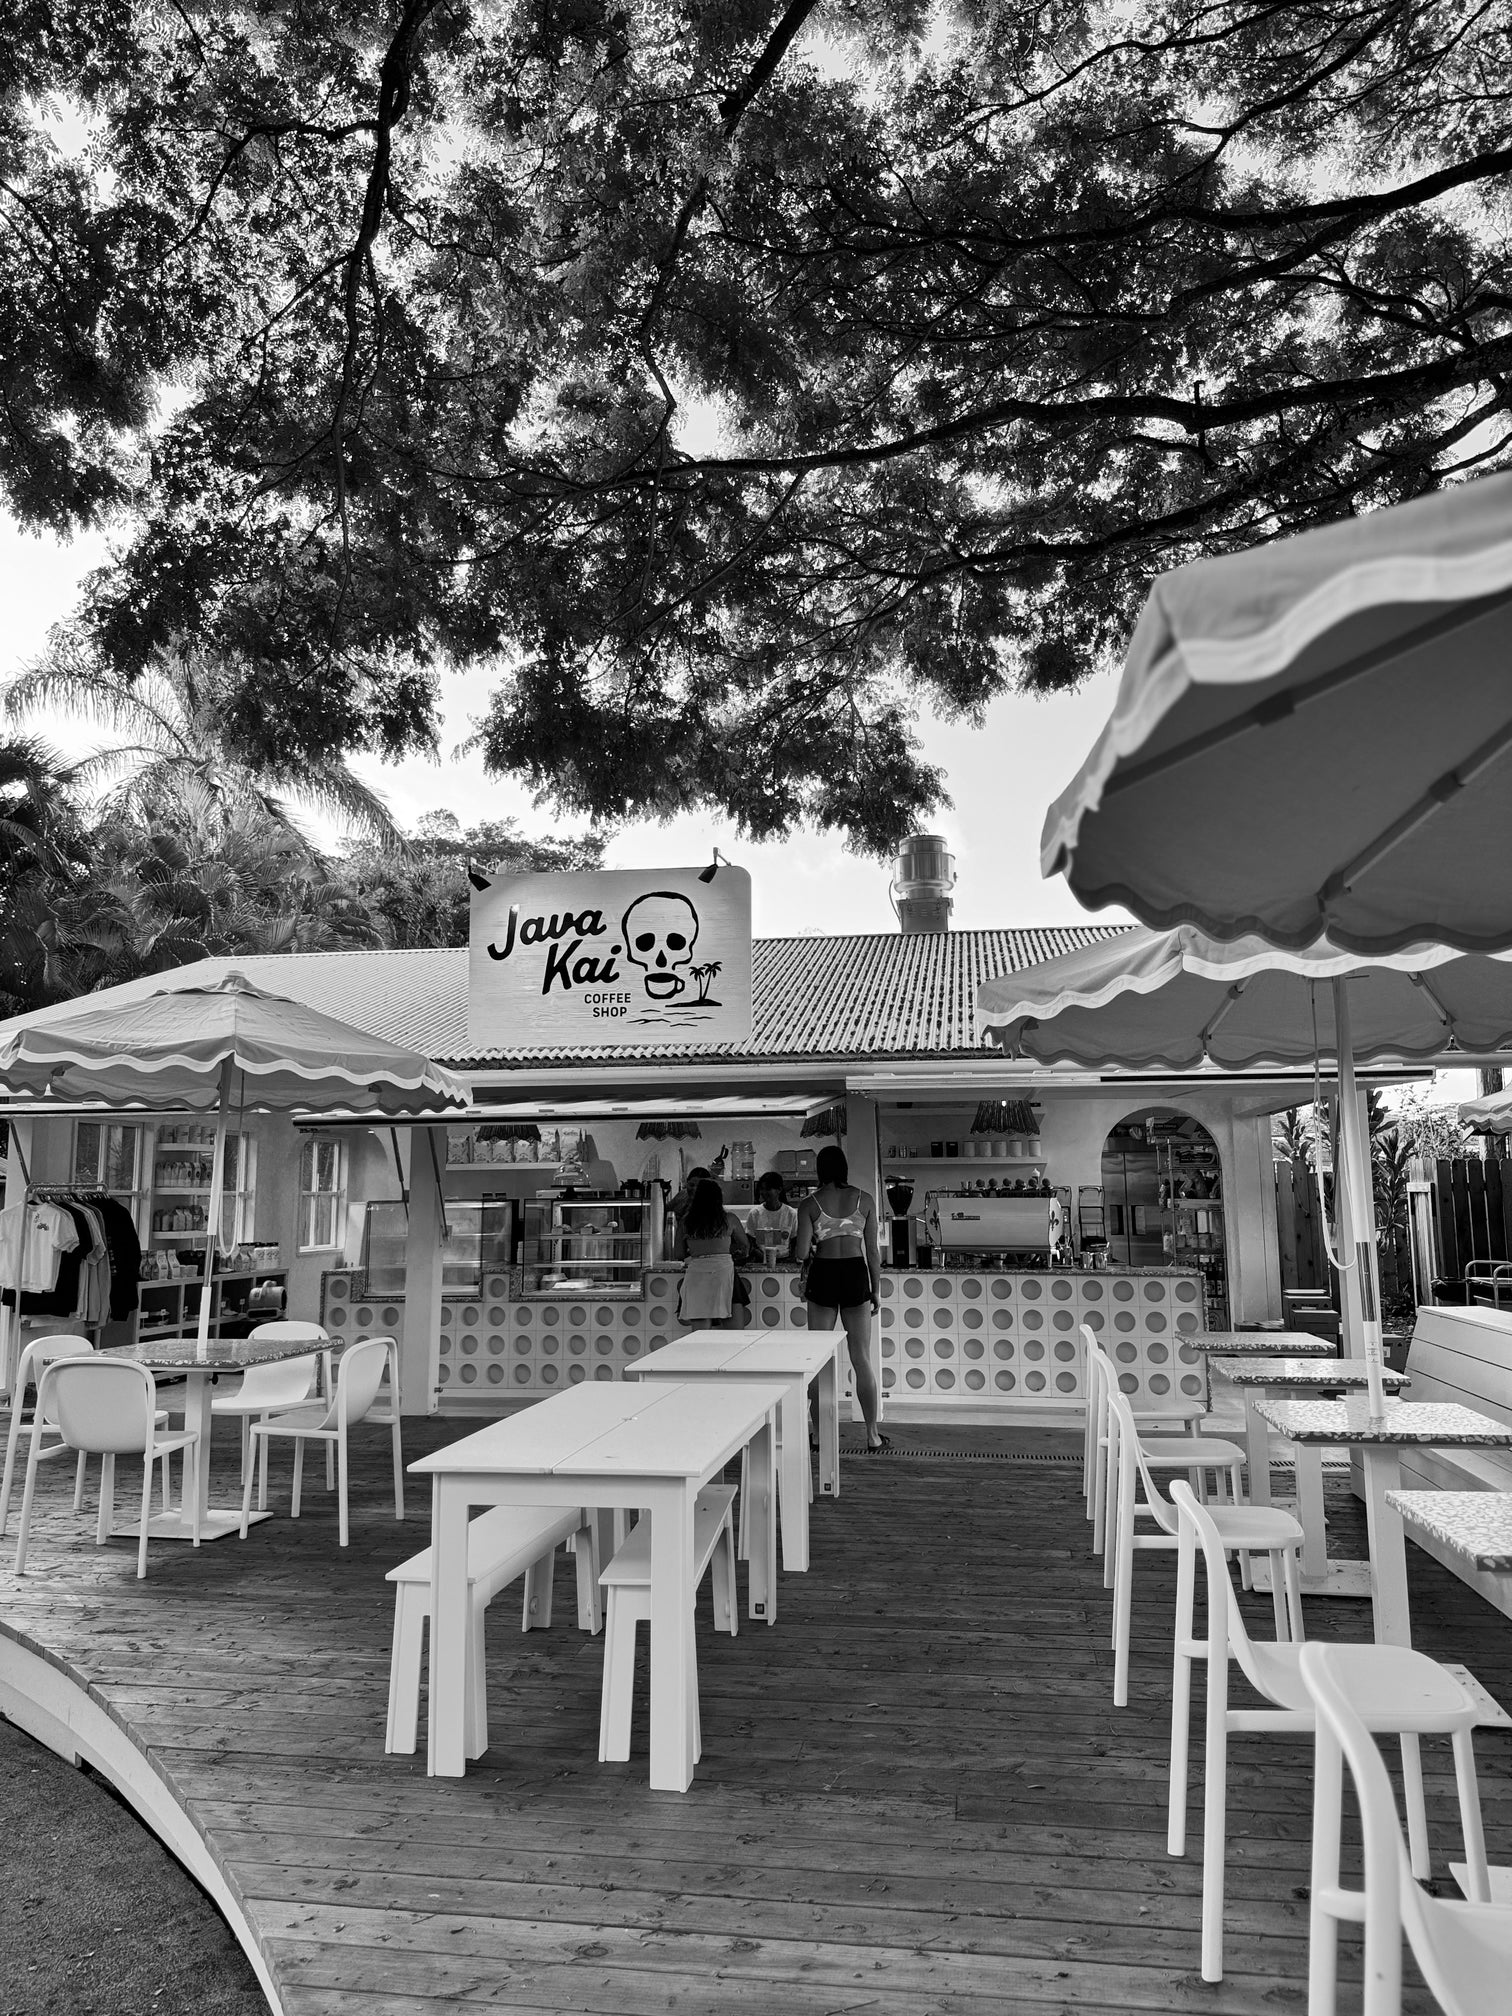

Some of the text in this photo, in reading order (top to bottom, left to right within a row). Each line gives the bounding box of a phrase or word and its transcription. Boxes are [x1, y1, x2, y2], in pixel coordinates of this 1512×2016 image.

[487, 904, 608, 961] Java
[542, 938, 623, 996] Kai
[584, 992, 632, 1004] COFFEE
[592, 1006, 628, 1018] SHOP
